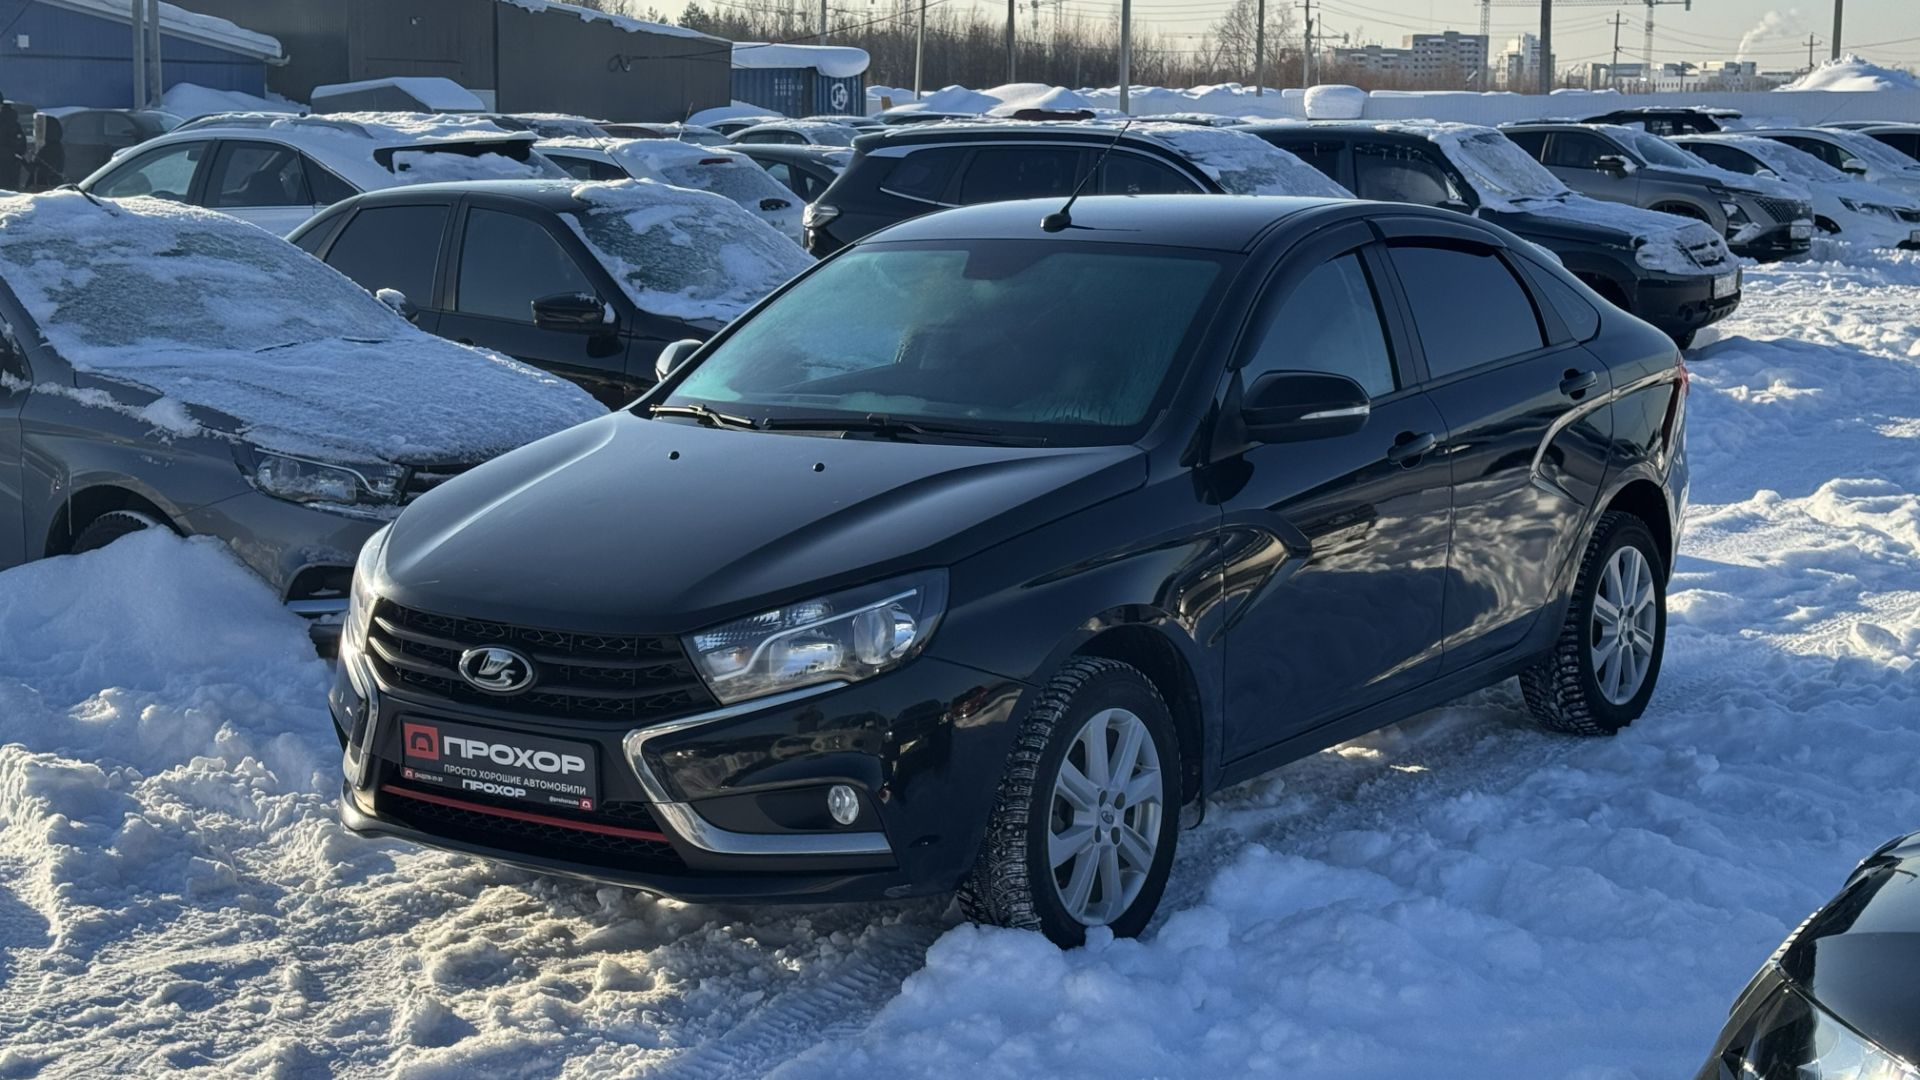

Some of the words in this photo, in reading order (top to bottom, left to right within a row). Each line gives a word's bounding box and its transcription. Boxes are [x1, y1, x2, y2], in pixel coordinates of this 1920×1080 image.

[443, 735, 586, 774] ПРОХОР
[444, 764, 477, 778] ПРОСТО
[478, 769, 521, 785] ХОРОШИЕ
[523, 778, 587, 796] АВТОМОБИЛИ
[462, 779, 526, 798] ПРОХОР
